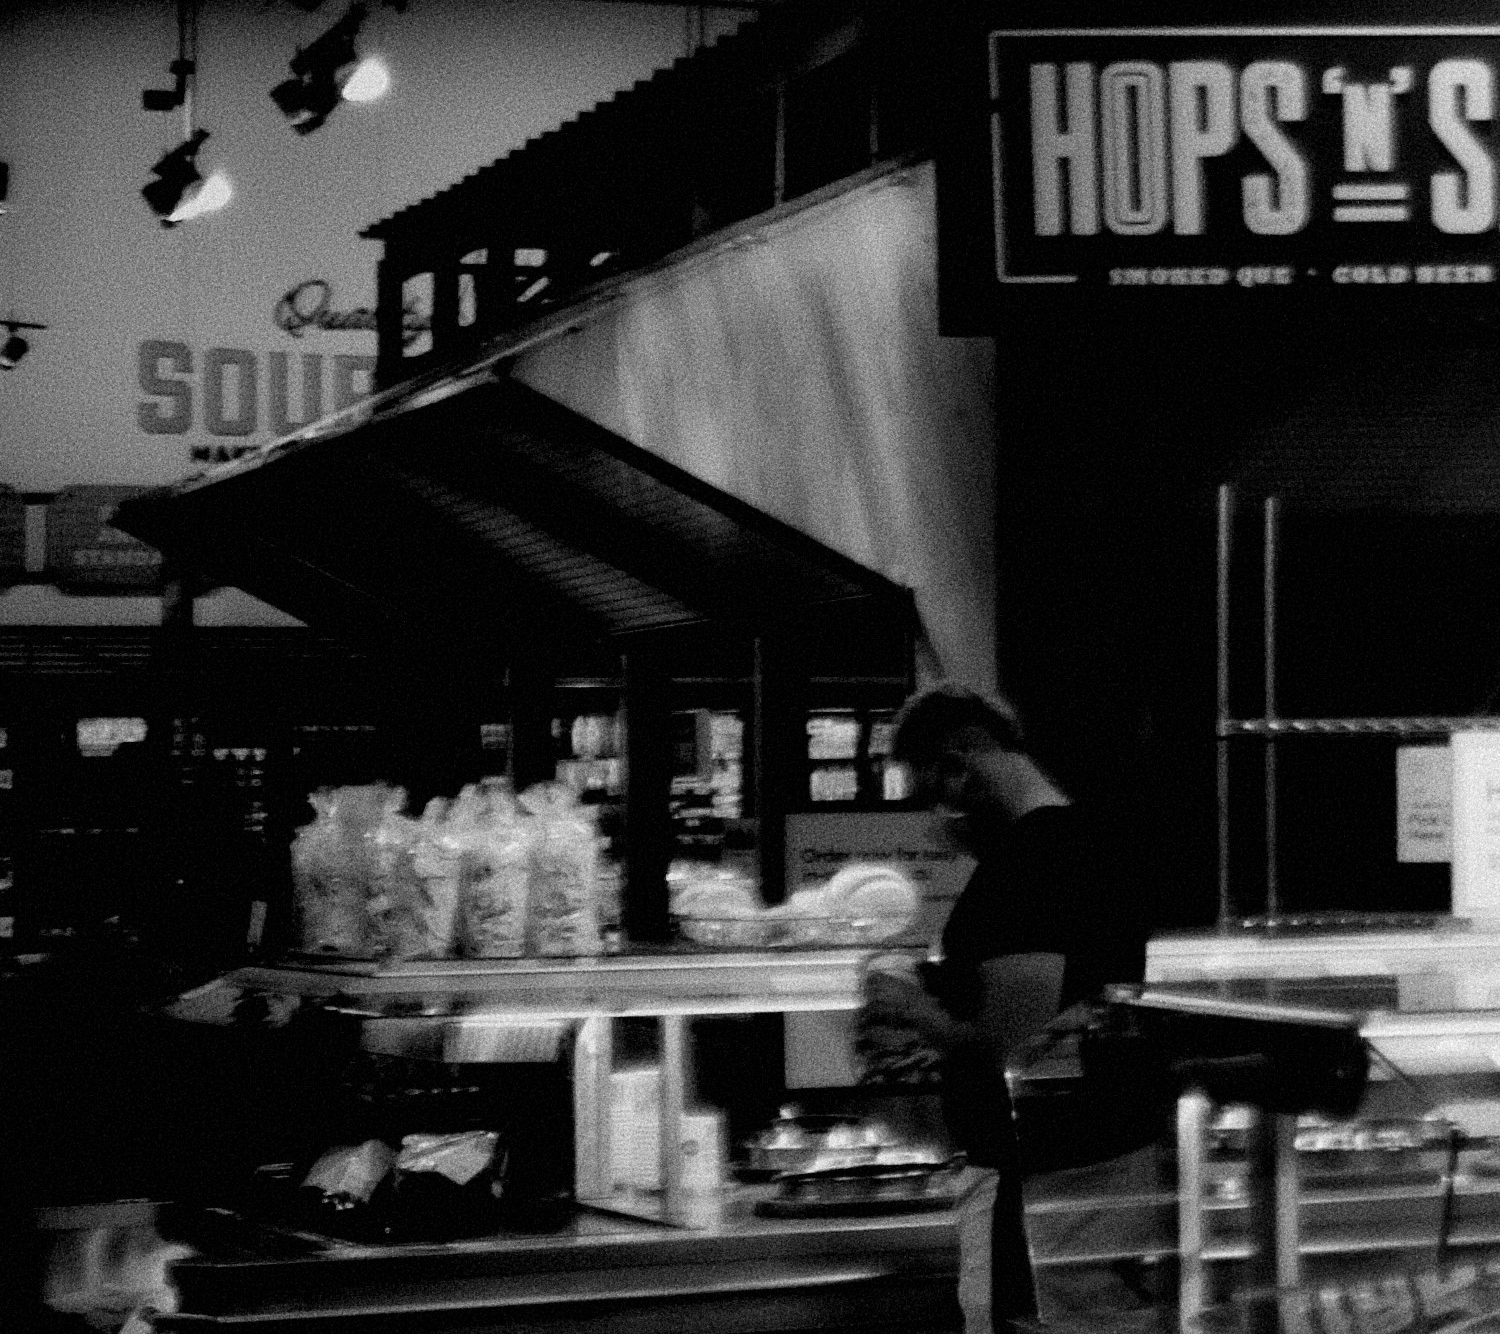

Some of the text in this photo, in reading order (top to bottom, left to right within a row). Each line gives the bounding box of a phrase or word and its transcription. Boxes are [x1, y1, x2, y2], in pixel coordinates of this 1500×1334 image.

[1031, 60, 1309, 236] HOPS
[1109, 267, 1229, 286] SMOKED
[1236, 267, 1293, 288] QUE
[1331, 265, 1410, 284] COLD
[1416, 265, 1494, 283] BEER
